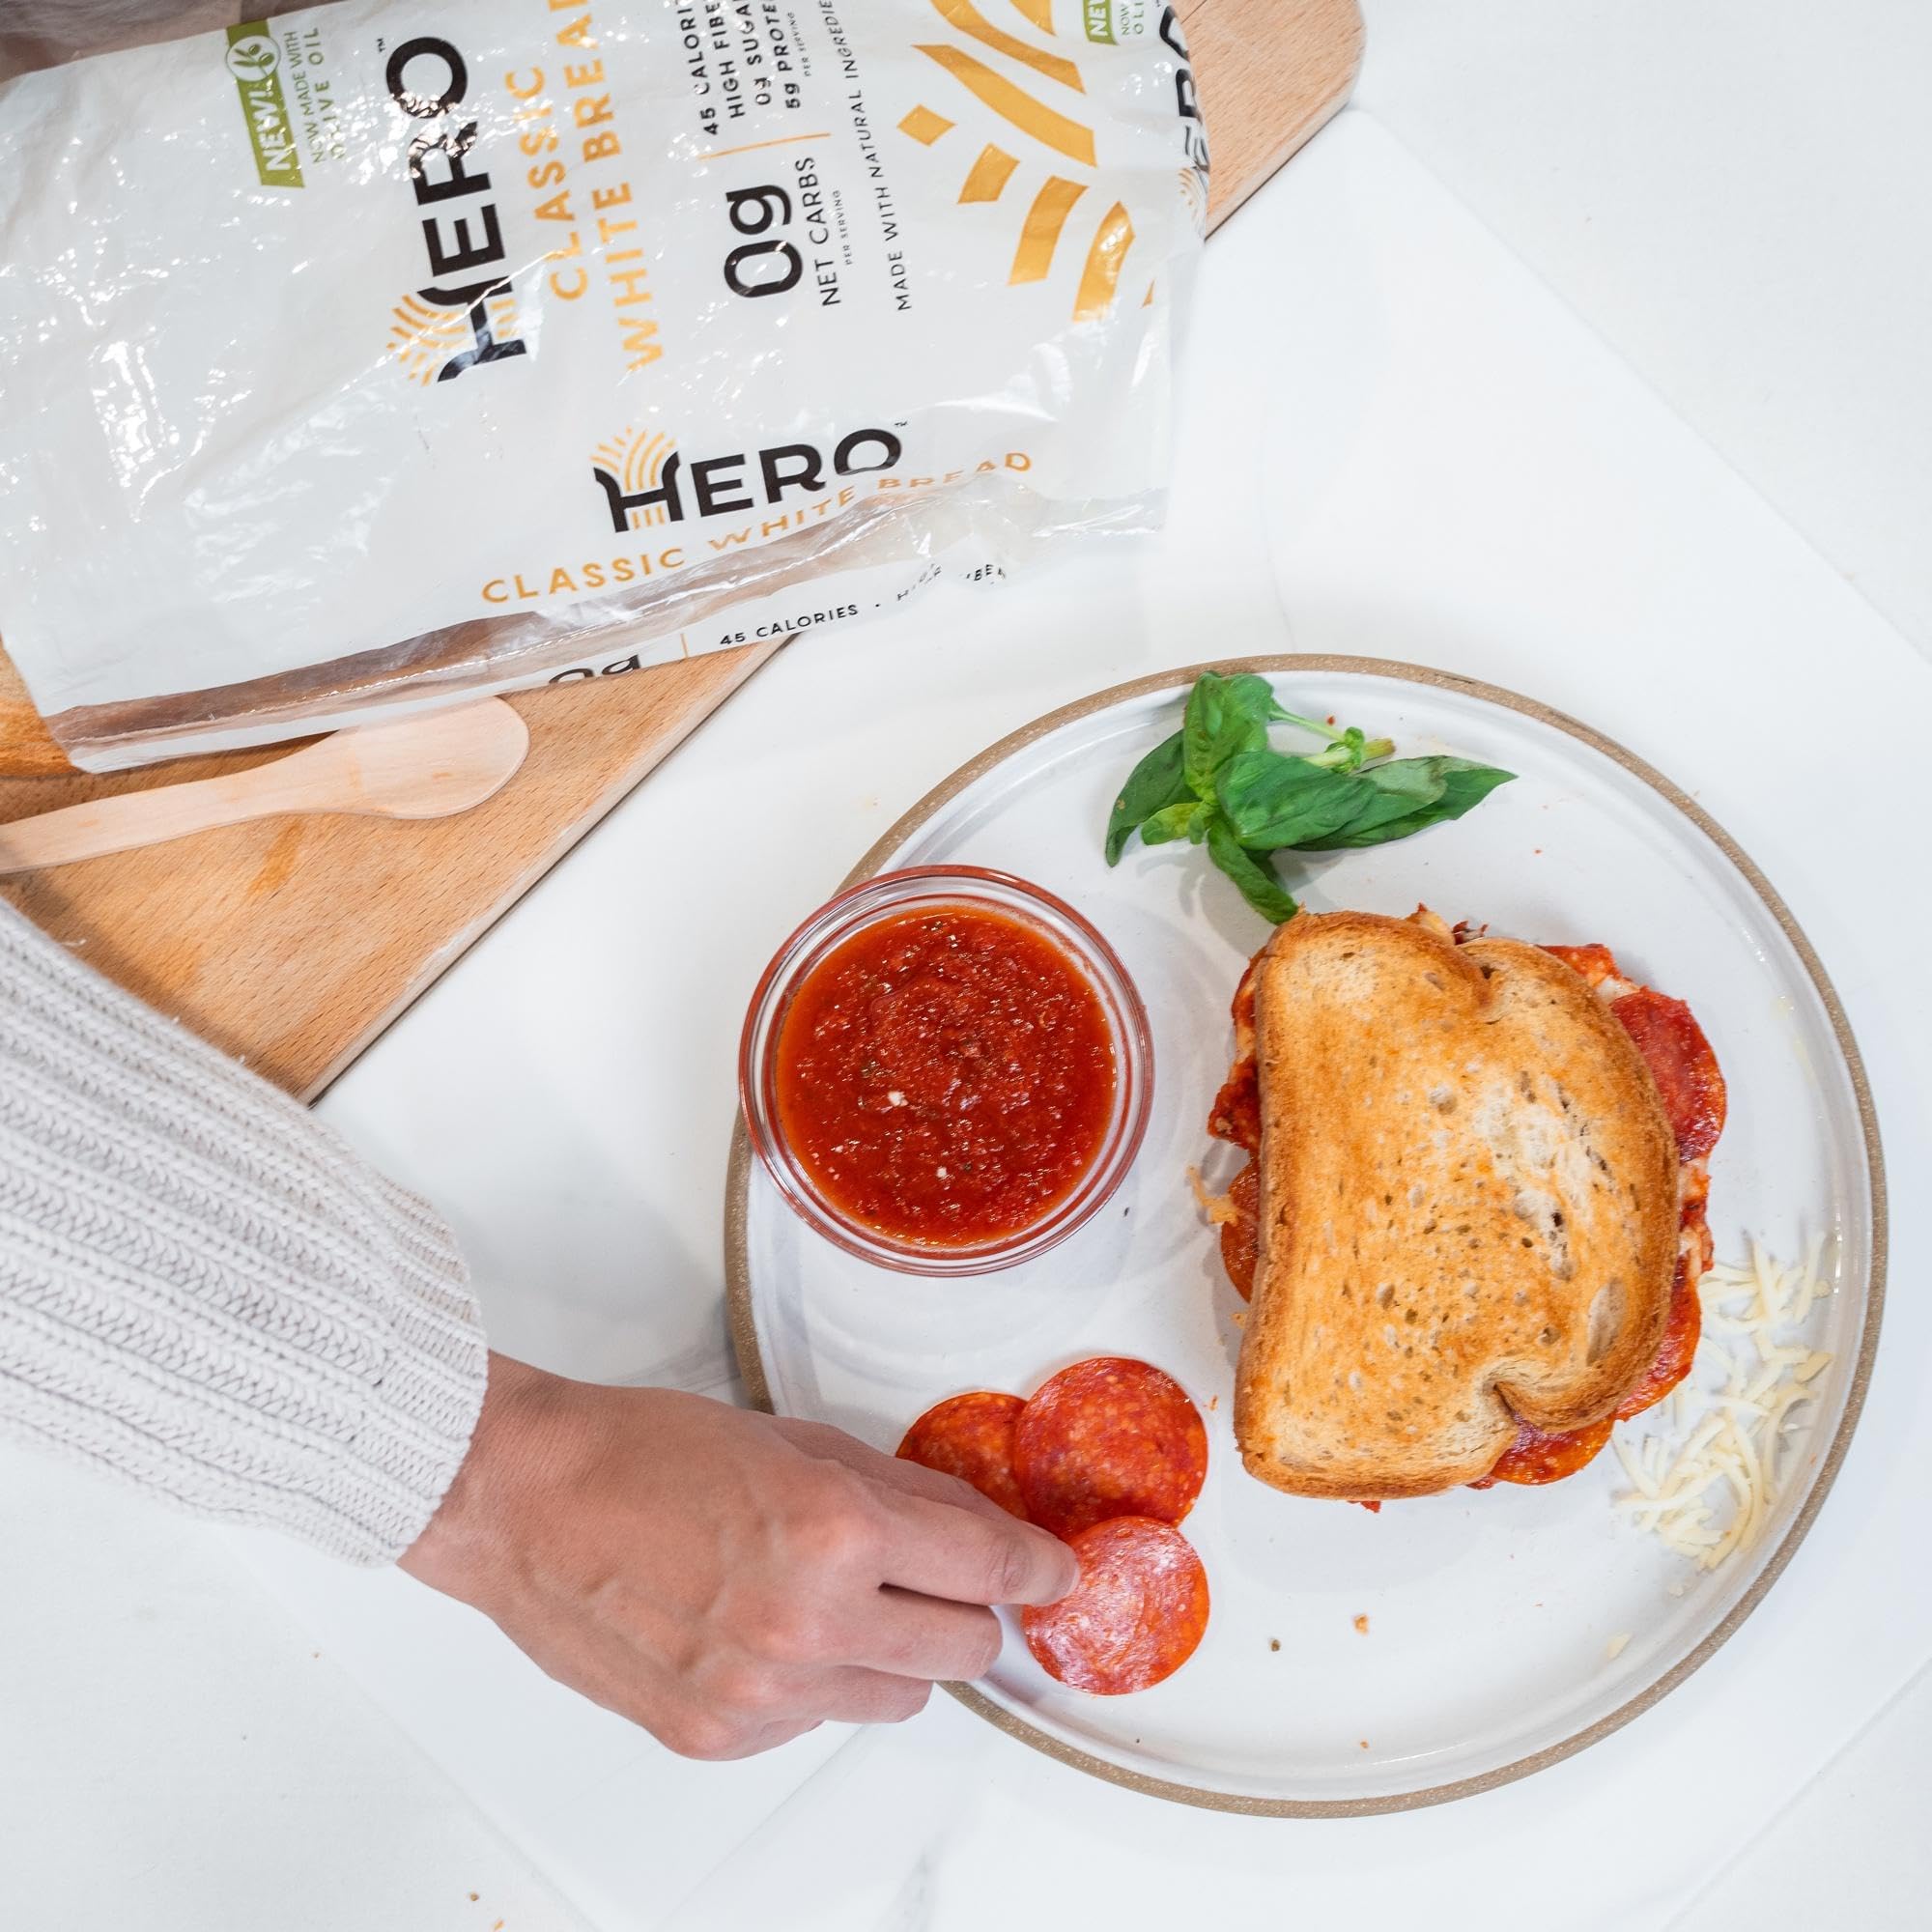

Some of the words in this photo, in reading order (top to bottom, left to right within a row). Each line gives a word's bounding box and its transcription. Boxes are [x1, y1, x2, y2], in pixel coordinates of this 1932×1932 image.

[303, 27, 324, 66] OIL
[705, 2, 730, 50] FIBE
[732, 0, 763, 66] SUGA
[762, 3, 792, 72] PROTE
[787, 12, 808, 52] SERVING
[819, 0, 860, 78] INGREDIE
[1133, 2, 1144, 35] OLI
[284, 31, 302, 69] WITH
[676, 7, 710, 95] CALORI
[803, 56, 812, 77] PER
[293, 71, 314, 116] MADE
[719, 60, 746, 119] HIGH
[781, 82, 801, 109] 5g
[699, 106, 720, 136] 45
[848, 89, 884, 178] NATURAL
[386, 37, 526, 383] HERO
[504, 66, 588, 302] CLASSIC
[795, 156, 829, 244] CARBS
[724, 184, 804, 298] 0g
[833, 189, 849, 240] SERVING
[874, 186, 899, 242] WITH
[591, 182, 663, 373] WHITE
[814, 259, 842, 306] NET
[842, 244, 853, 266] PER
[888, 250, 912, 311] MADE
[593, 428, 902, 533] HERO
[481, 547, 685, 604] CLASSIC
[708, 485, 856, 551] WHITE
[720, 633, 746, 645] 45
[755, 604, 859, 638] CALORIES
